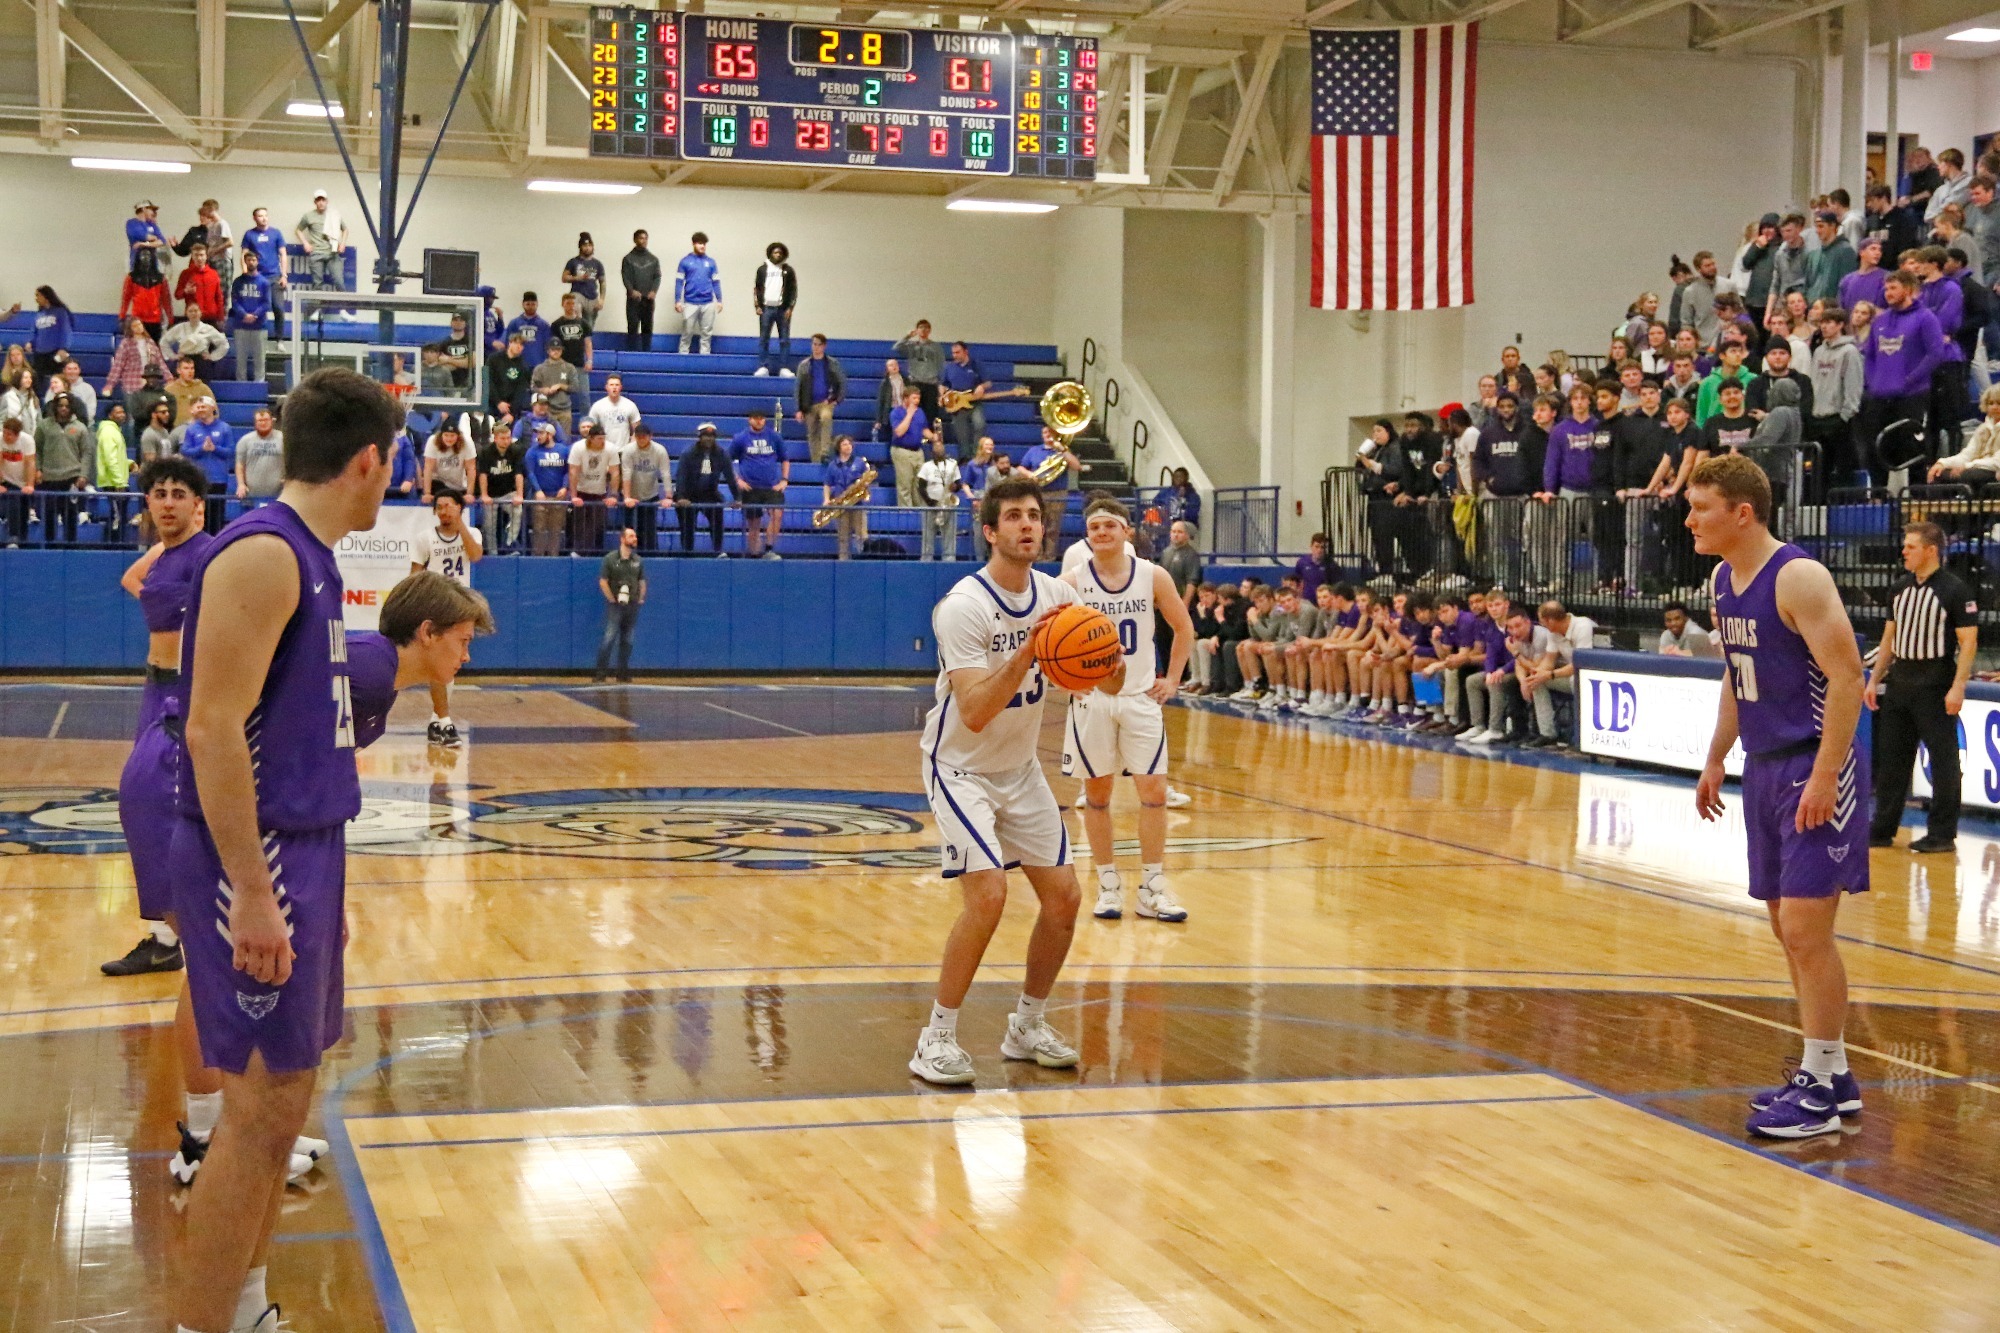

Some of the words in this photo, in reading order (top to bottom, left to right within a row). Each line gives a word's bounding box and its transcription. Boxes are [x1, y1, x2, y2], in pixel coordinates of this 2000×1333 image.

[597, 8, 614, 21] NO
[630, 10, 637, 22] F
[652, 12, 674, 24] PTS
[611, 22, 618, 40] 1
[635, 23, 648, 42] 2
[659, 25, 678, 44] 16
[706, 20, 758, 40] HOME
[819, 30, 882, 65] 2.8
[933, 34, 1000, 55] VISITOR
[1023, 35, 1038, 47] NO
[1054, 37, 1061, 48] F
[1074, 39, 1094, 50] PTS
[593, 43, 617, 63] 20
[636, 46, 648, 64] 3
[664, 47, 677, 67] 9
[715, 44, 757, 79] 65
[1035, 49, 1042, 66] 1
[1058, 50, 1069, 67] 3
[1080, 51, 1097, 69] 10
[593, 66, 617, 86] 23
[635, 69, 647, 87] 2
[664, 71, 677, 89] 7
[795, 67, 817, 77] POSS
[885, 72, 906, 82] POSS
[950, 58, 992, 92] 61
[1029, 70, 1041, 88] 3
[1057, 72, 1069, 89] 3
[1073, 72, 1097, 91] 24
[593, 89, 617, 108] 24
[635, 92, 647, 110] 4
[664, 93, 677, 112] 9
[722, 84, 759, 97] BONUS
[820, 82, 860, 95] PERIOD
[864, 79, 881, 105] 2
[702, 103, 737, 116] FOULS
[749, 106, 770, 119] TOL
[940, 97, 976, 109] BONUS
[1024, 92, 1041, 110] 10
[1057, 94, 1069, 111] 4
[1083, 95, 1096, 113] 0
[593, 112, 617, 131] 25
[634, 115, 647, 132] 2
[663, 117, 676, 135] 2
[793, 109, 834, 122] PLAYER
[841, 111, 880, 124] POINTS
[885, 113, 919, 126] FOULS
[929, 116, 949, 128] TOL
[962, 118, 995, 130] FOULS
[1018, 113, 1041, 131] 20
[1061, 117, 1068, 133] 1
[1083, 117, 1095, 134] 5
[712, 118, 737, 144] 10
[751, 119, 768, 147] 0
[797, 121, 831, 150] 23
[861, 125, 879, 151] 7
[885, 127, 903, 154] 2
[710, 146, 733, 157] WON
[930, 129, 948, 155] 0
[970, 132, 993, 157] 10
[1018, 135, 1040, 153] 25
[1057, 137, 1068, 154] 3
[1083, 138, 1095, 156] 5
[848, 154, 876, 165] GAME
[964, 159, 987, 170] WON
[340, 535, 409, 553] Division
[433, 545, 465, 557] SPARTAN
[442, 556, 464, 577] 24
[342, 589, 377, 606] NE
[1115, 619, 1137, 655] 0
[1591, 733, 1632, 750] SPARTANS
